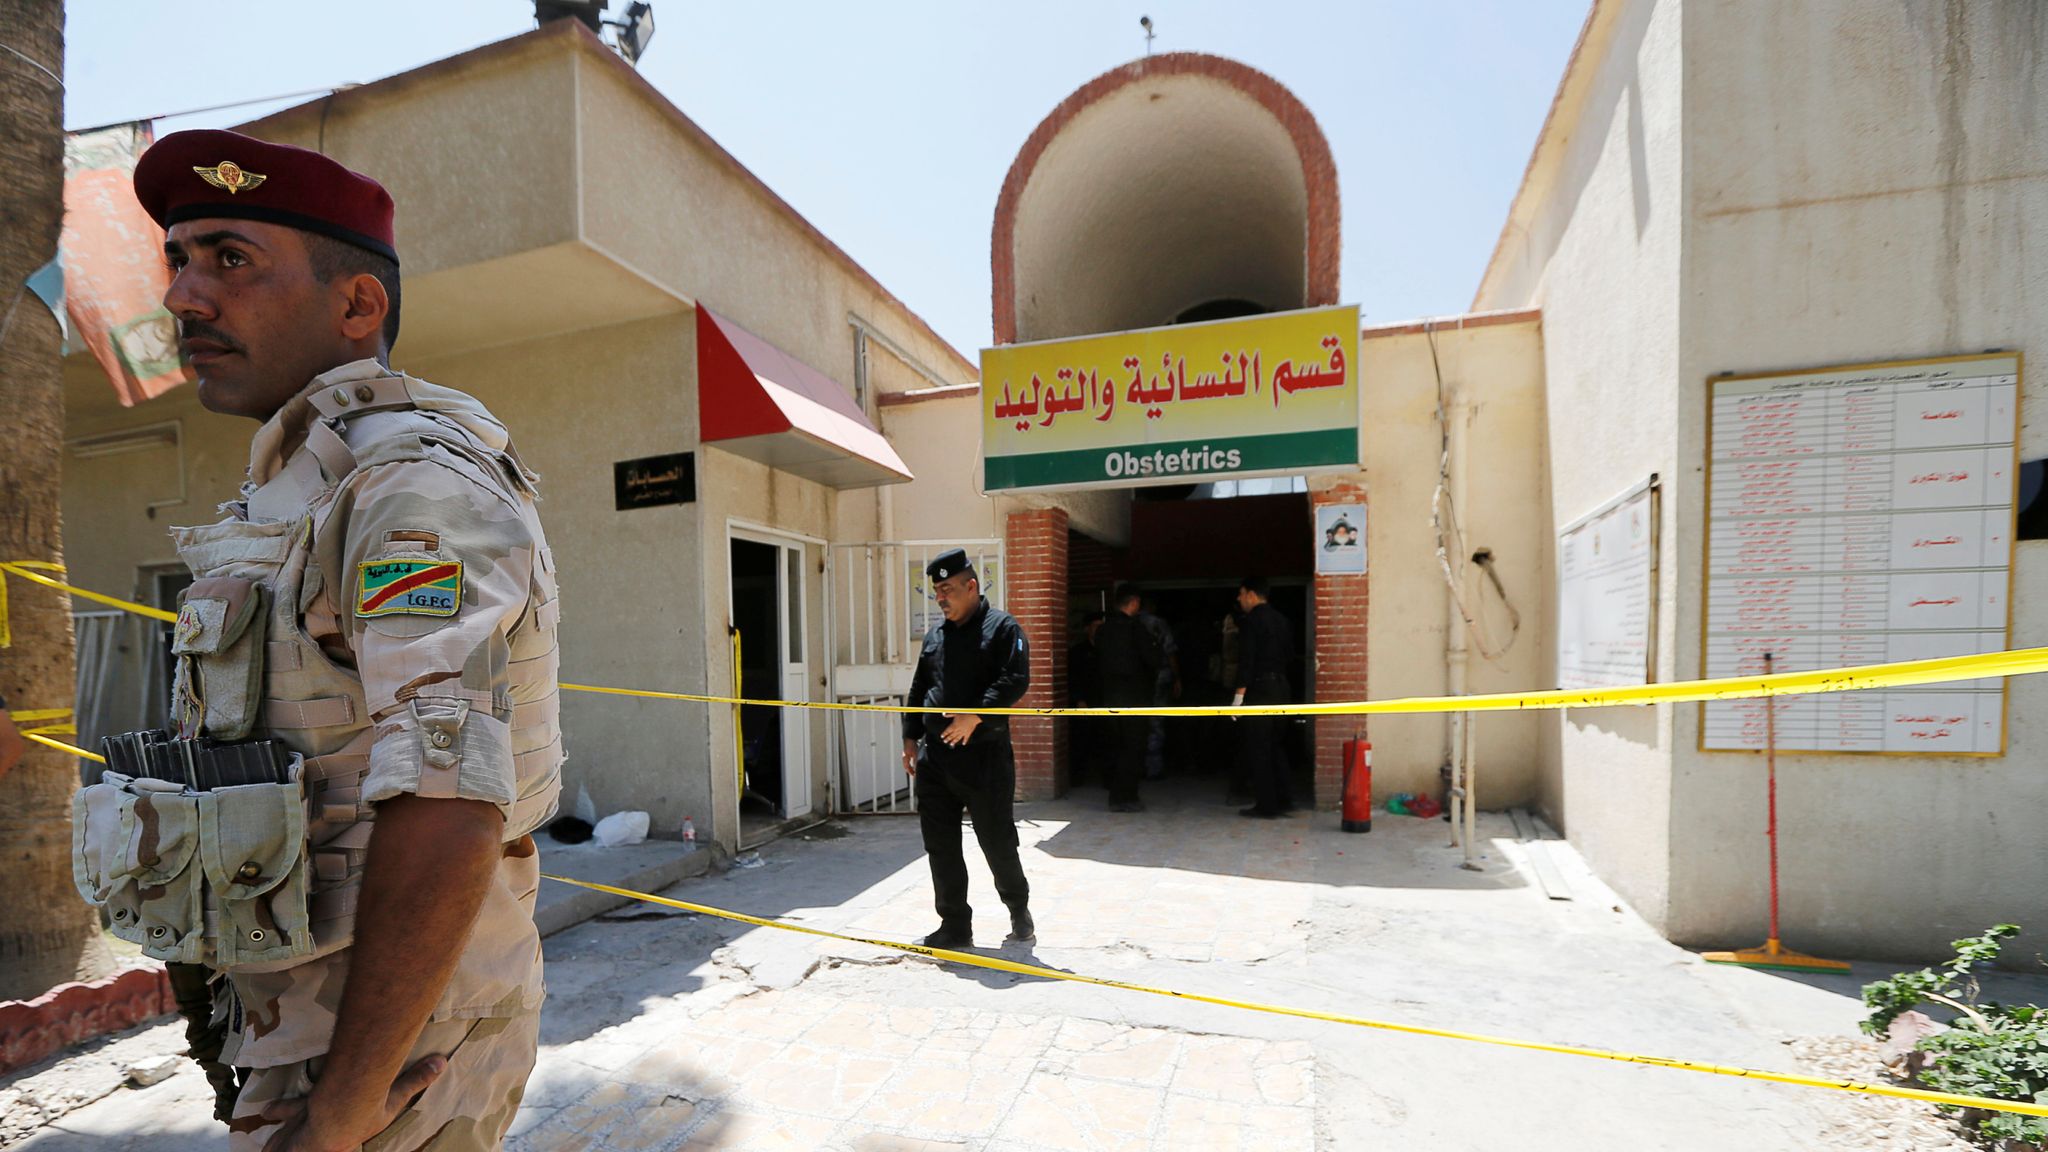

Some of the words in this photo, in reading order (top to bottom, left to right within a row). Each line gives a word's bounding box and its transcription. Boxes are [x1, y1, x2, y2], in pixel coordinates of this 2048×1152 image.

[994, 366, 1115, 432] والتوليد
[1124, 350, 1261, 419] النسائية
[1272, 336, 1346, 408] قسم
[1105, 446, 1241, 477] Obstetrics
